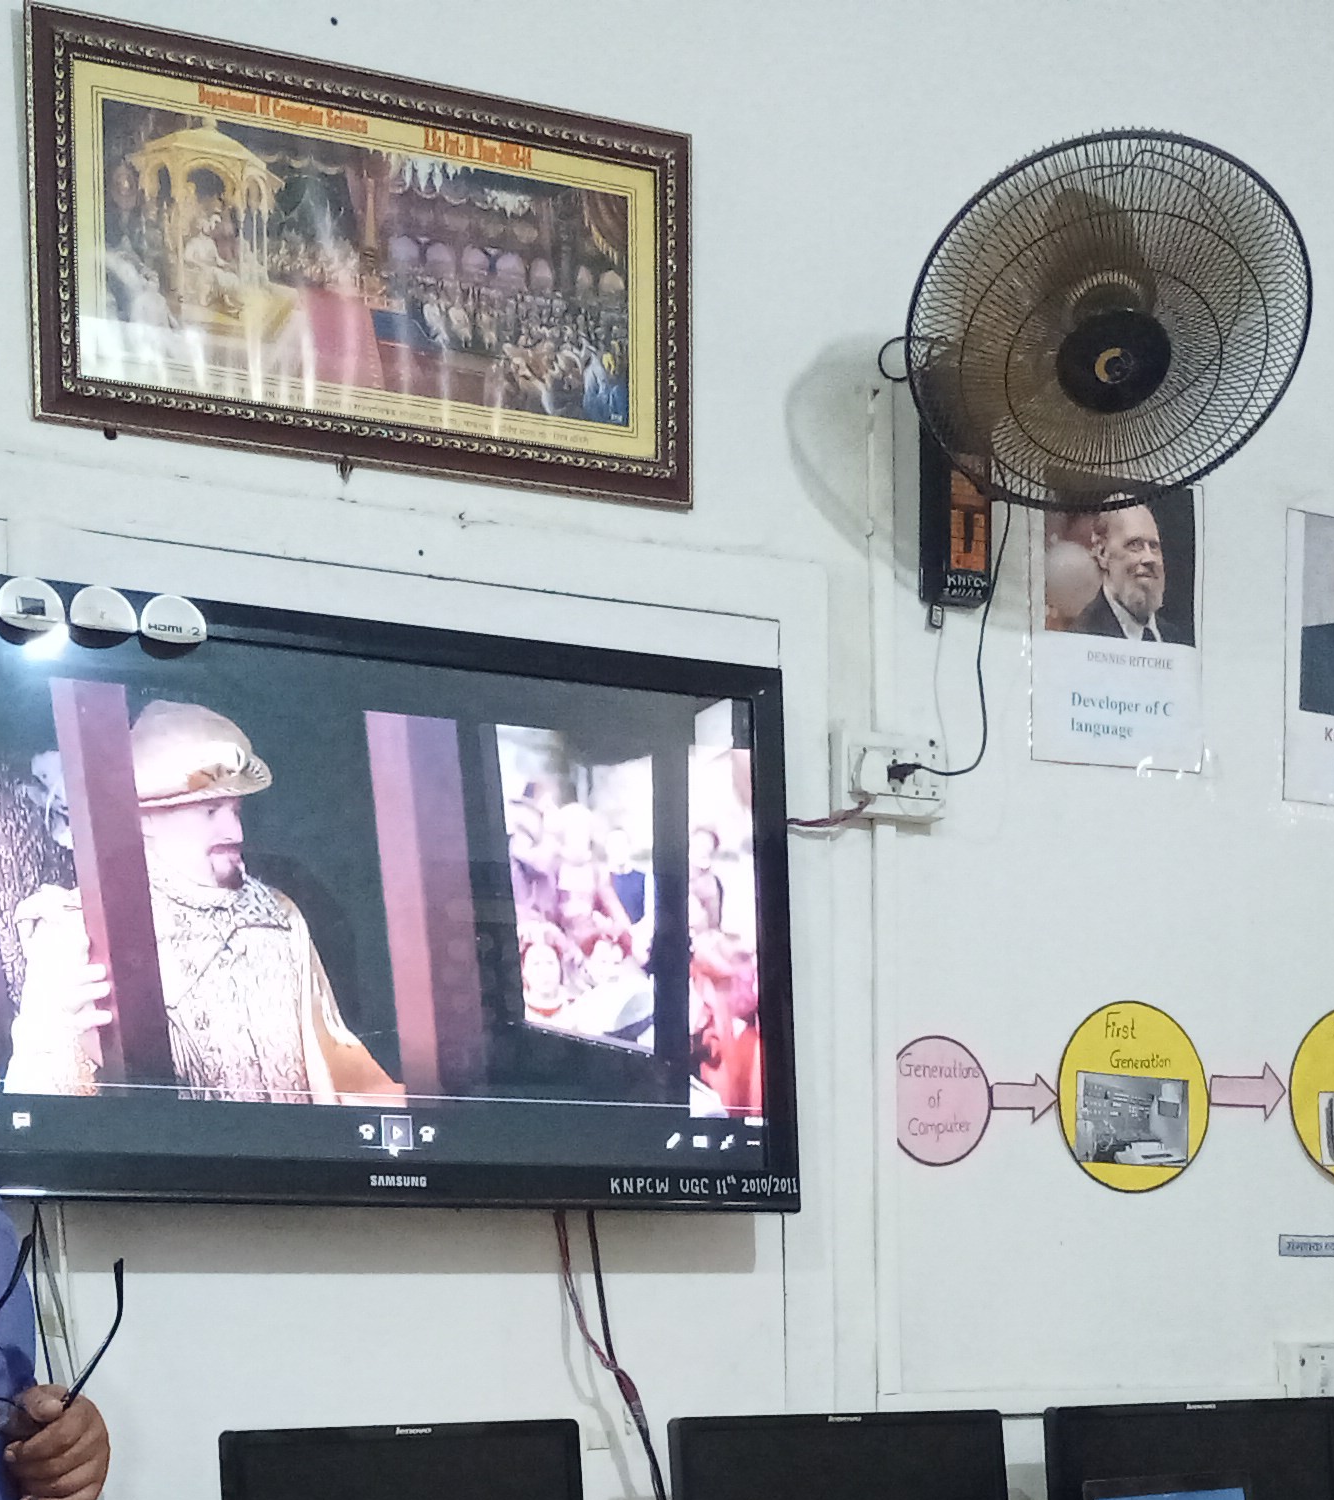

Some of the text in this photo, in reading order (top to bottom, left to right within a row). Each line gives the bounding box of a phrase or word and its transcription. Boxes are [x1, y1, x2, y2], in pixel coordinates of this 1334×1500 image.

[148, 622, 201, 636] HDMI 2
[1087, 650, 1173, 670] DENNIS RITCHIE
[1071, 691, 1175, 717] Developer of C
[1071, 717, 1134, 739] language
[1103, 1011, 1137, 1040] First
[898, 1052, 981, 1080] Generations
[1109, 1049, 1172, 1070] Generation
[928, 1091, 942, 1111] of
[908, 1117, 971, 1143] Computer
[369, 1174, 428, 1188] SAMSUNG
[610, 1177, 669, 1195] KNPCW
[679, 1177, 710, 1195] UGC
[741, 1174, 799, 1197] 2010/2011
